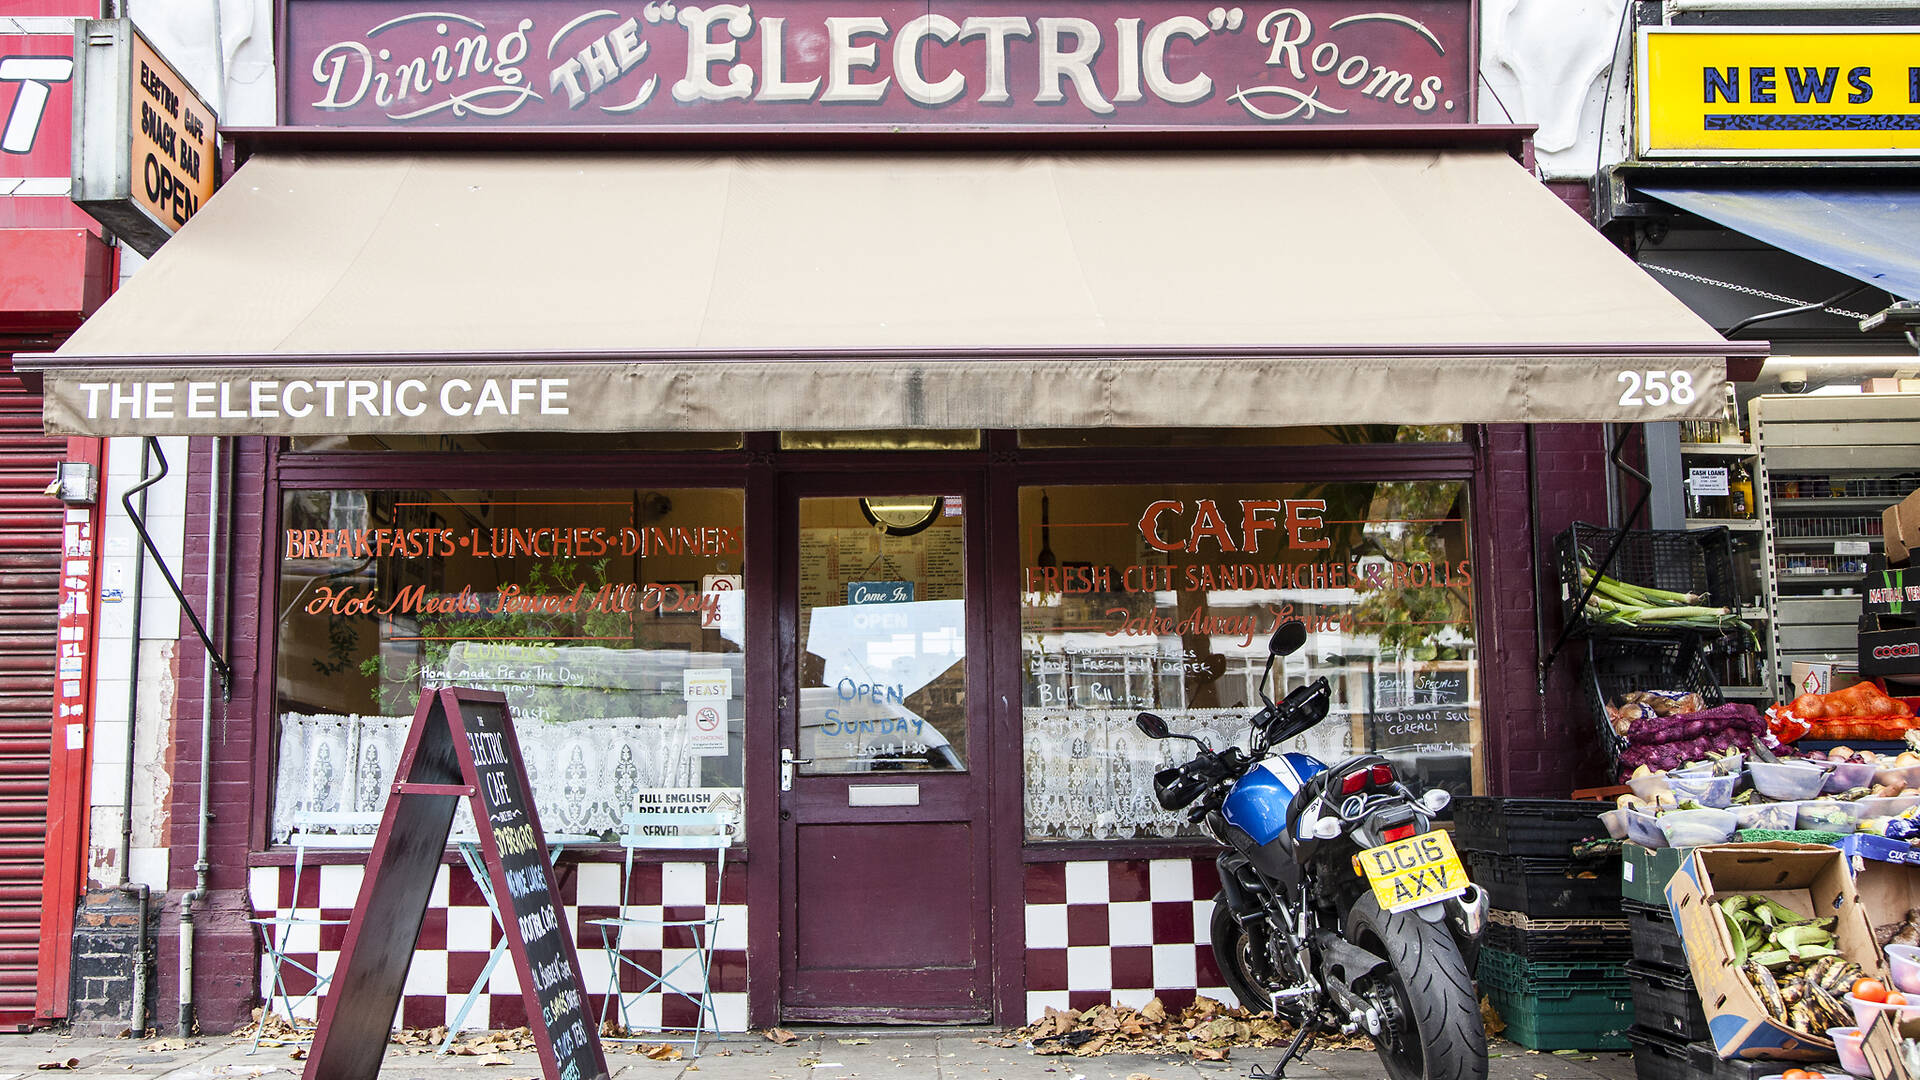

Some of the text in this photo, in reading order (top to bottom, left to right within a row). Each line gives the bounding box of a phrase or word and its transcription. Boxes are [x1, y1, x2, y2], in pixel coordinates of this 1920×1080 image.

[311, 18, 534, 108] Dining
[549, 17, 648, 110] THE
[1256, 7, 1454, 112] Rooms.
[141, 60, 204, 145] ELECTRIC CAFE
[1703, 66, 1873, 104] NEWS
[142, 101, 200, 183] SNACK BAR
[144, 153, 198, 225] OPEN
[79, 378, 570, 420] THE ELECTRIC CAFE
[1617, 370, 1696, 406] 258
[285, 527, 742, 560] BREAKFASTS LUNCHES DINNERS
[1137, 499, 1331, 553] CAFE
[854, 586, 908, 604] Come In
[1026, 560, 1472, 594] FRESH CUT SANDWICHES & ROLLS
[1869, 587, 1904, 603] NATURAL
[306, 586, 376, 616] Hot
[377, 584, 481, 615] Meals
[486, 583, 584, 614] Served
[585, 582, 637, 614] All
[637, 583, 720, 626] Day
[1105, 607, 1173, 637] Take
[1172, 606, 1256, 648] Away
[838, 678, 904, 705] OPEN
[821, 709, 924, 737] SUNDAY
[1388, 722, 1438, 735] CEREAL!
[1399, 712, 1413, 722] DO
[1417, 711, 1439, 721] NOT
[486, 771, 512, 807] CAFE
[639, 793, 711, 804] FULL ENGLISH
[1373, 837, 1444, 875] DG16
[1394, 864, 1448, 902] AXV
